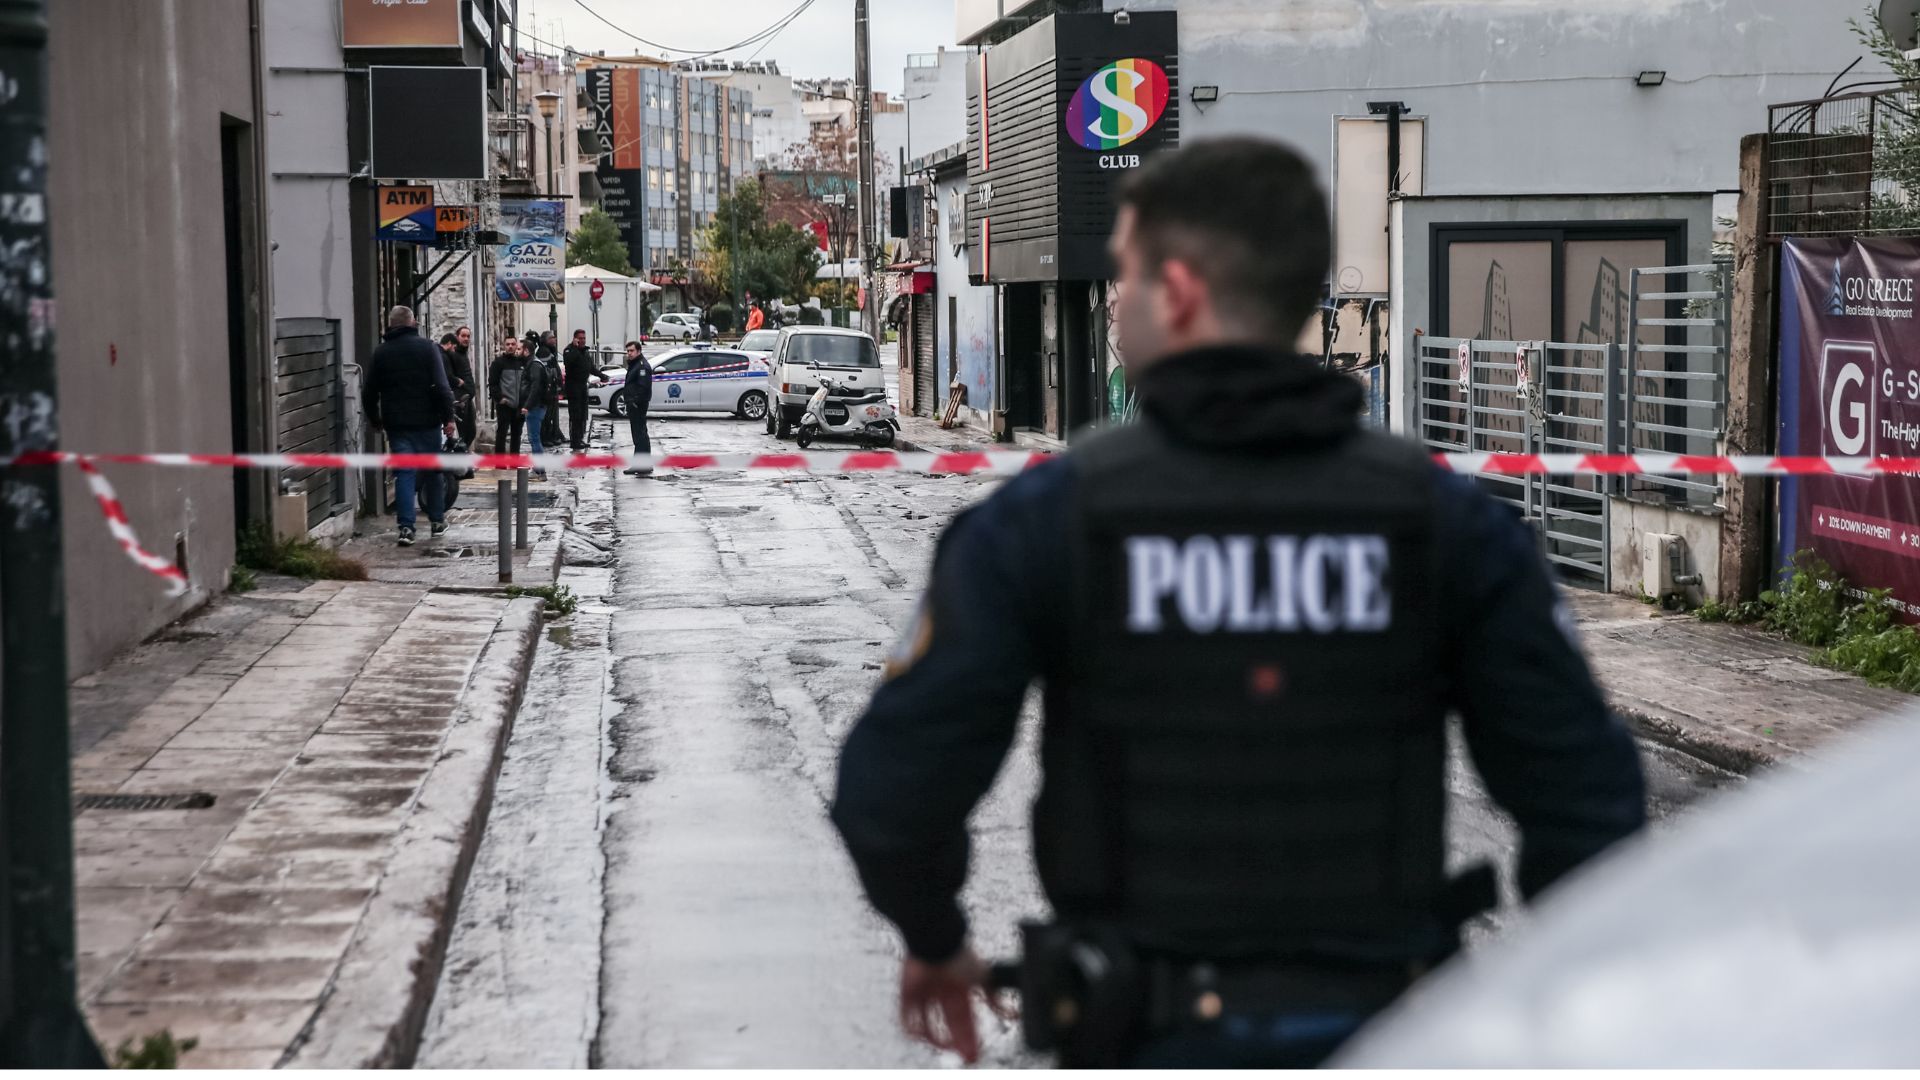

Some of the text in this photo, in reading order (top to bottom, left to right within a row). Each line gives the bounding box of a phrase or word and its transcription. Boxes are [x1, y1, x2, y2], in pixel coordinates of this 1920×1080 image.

[1087, 67, 1148, 139] S
[1098, 154, 1141, 169] CLUB
[386, 191, 427, 205] ATM
[509, 244, 552, 257] GAZI
[1845, 277, 1913, 302] GO GREECE
[1845, 305, 1913, 320] Real Estate Development
[1882, 368, 1894, 397] G
[1907, 370, 1920, 399] S
[1829, 362, 1866, 455] G
[1881, 419, 1899, 440] The
[1828, 515, 1892, 541] 10% DOWN PAYMENT
[1125, 534, 1391, 632] POLICE
